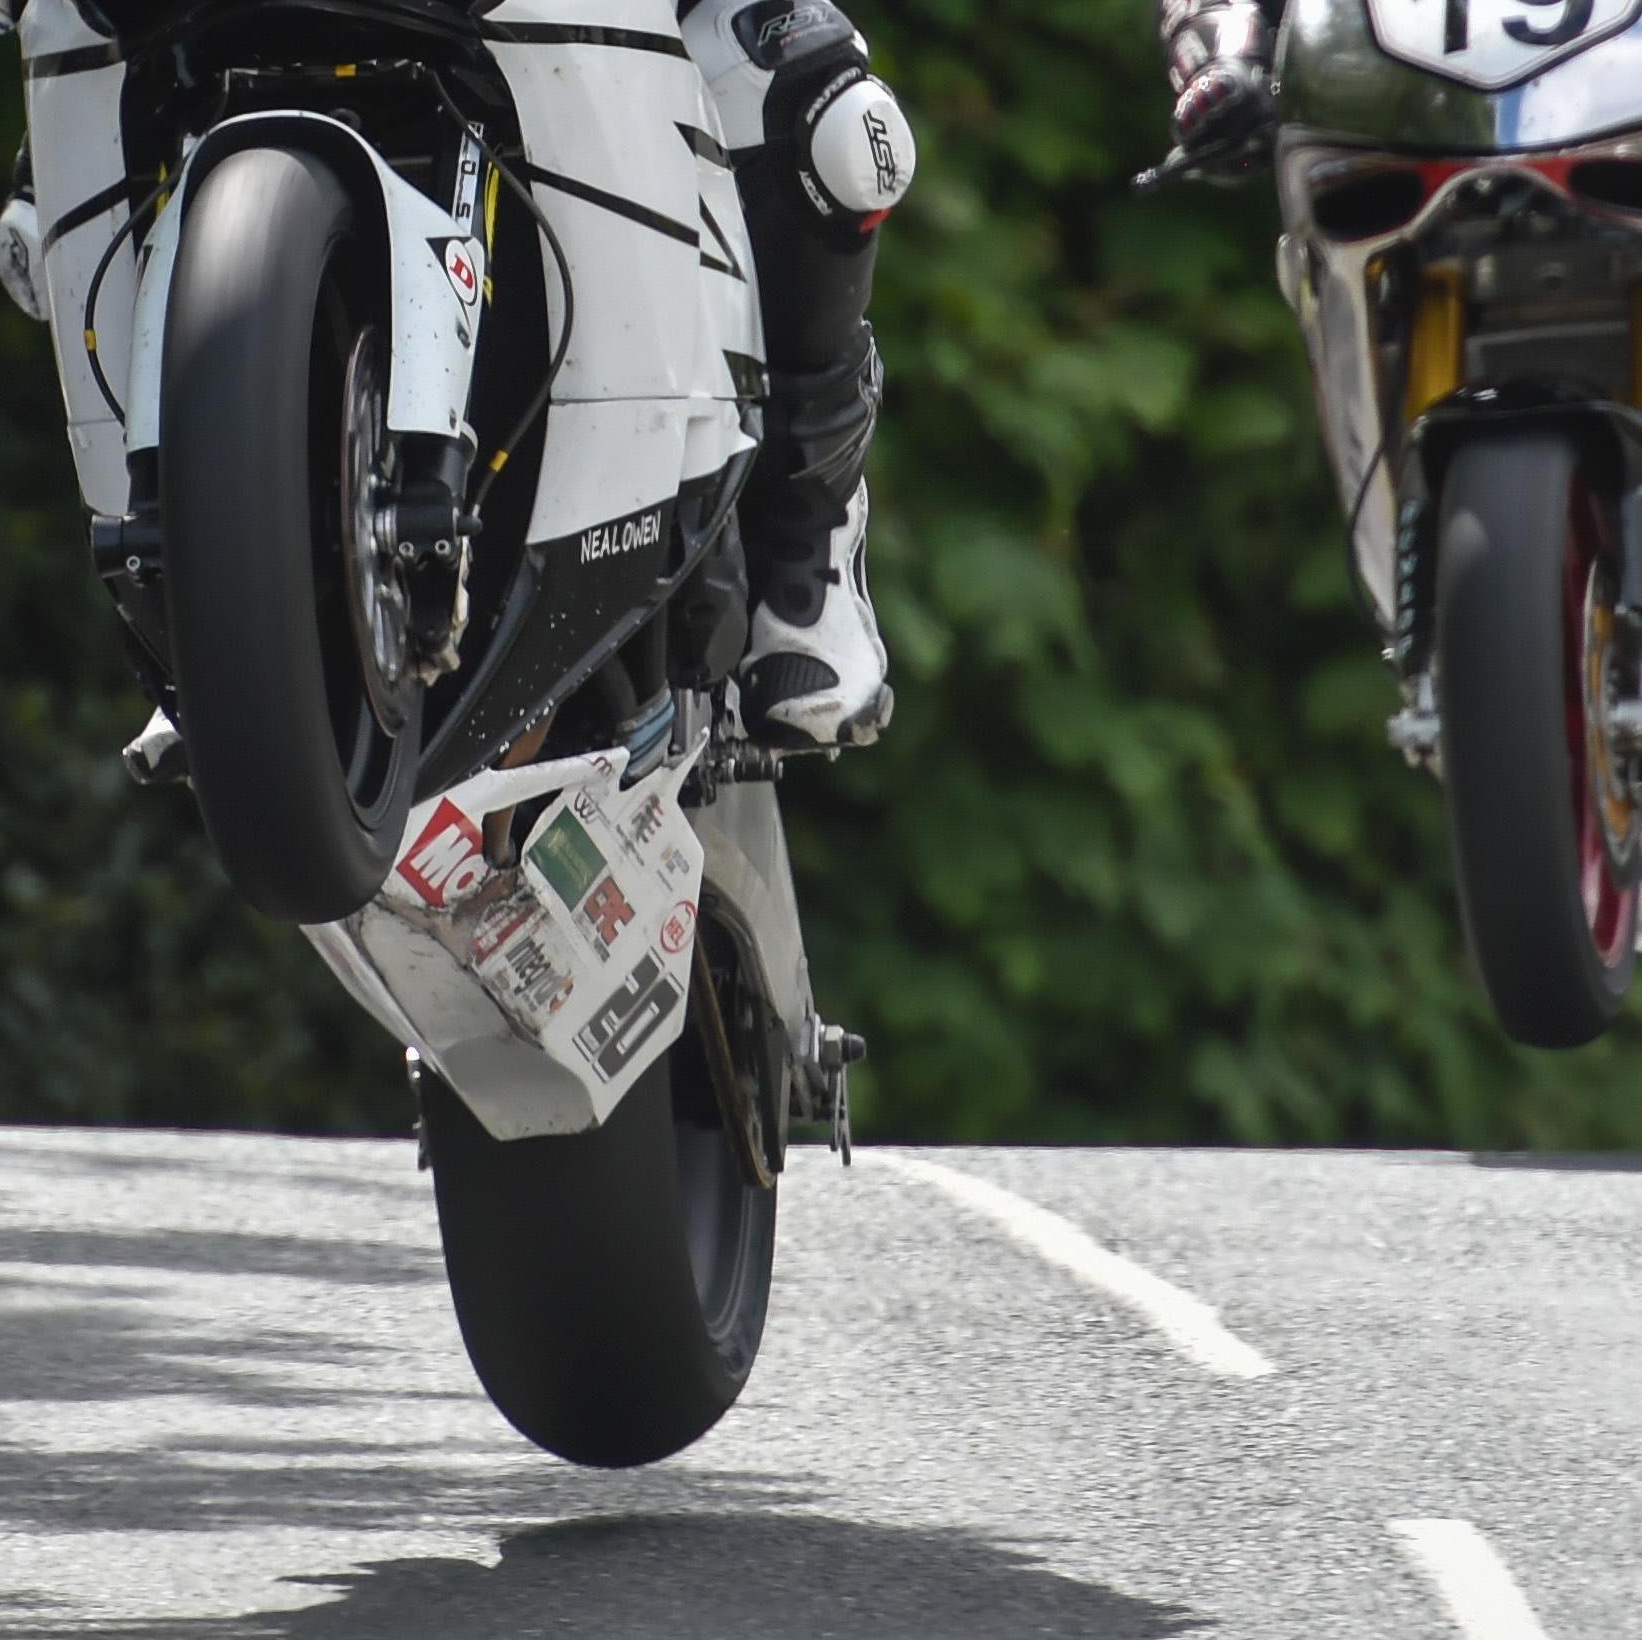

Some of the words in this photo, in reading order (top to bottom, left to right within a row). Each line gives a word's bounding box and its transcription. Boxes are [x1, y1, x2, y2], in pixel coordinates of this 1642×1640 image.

[581, 525, 620, 564] NEAL
[622, 510, 661, 552] OWEN
[573, 947, 686, 1083] 20
